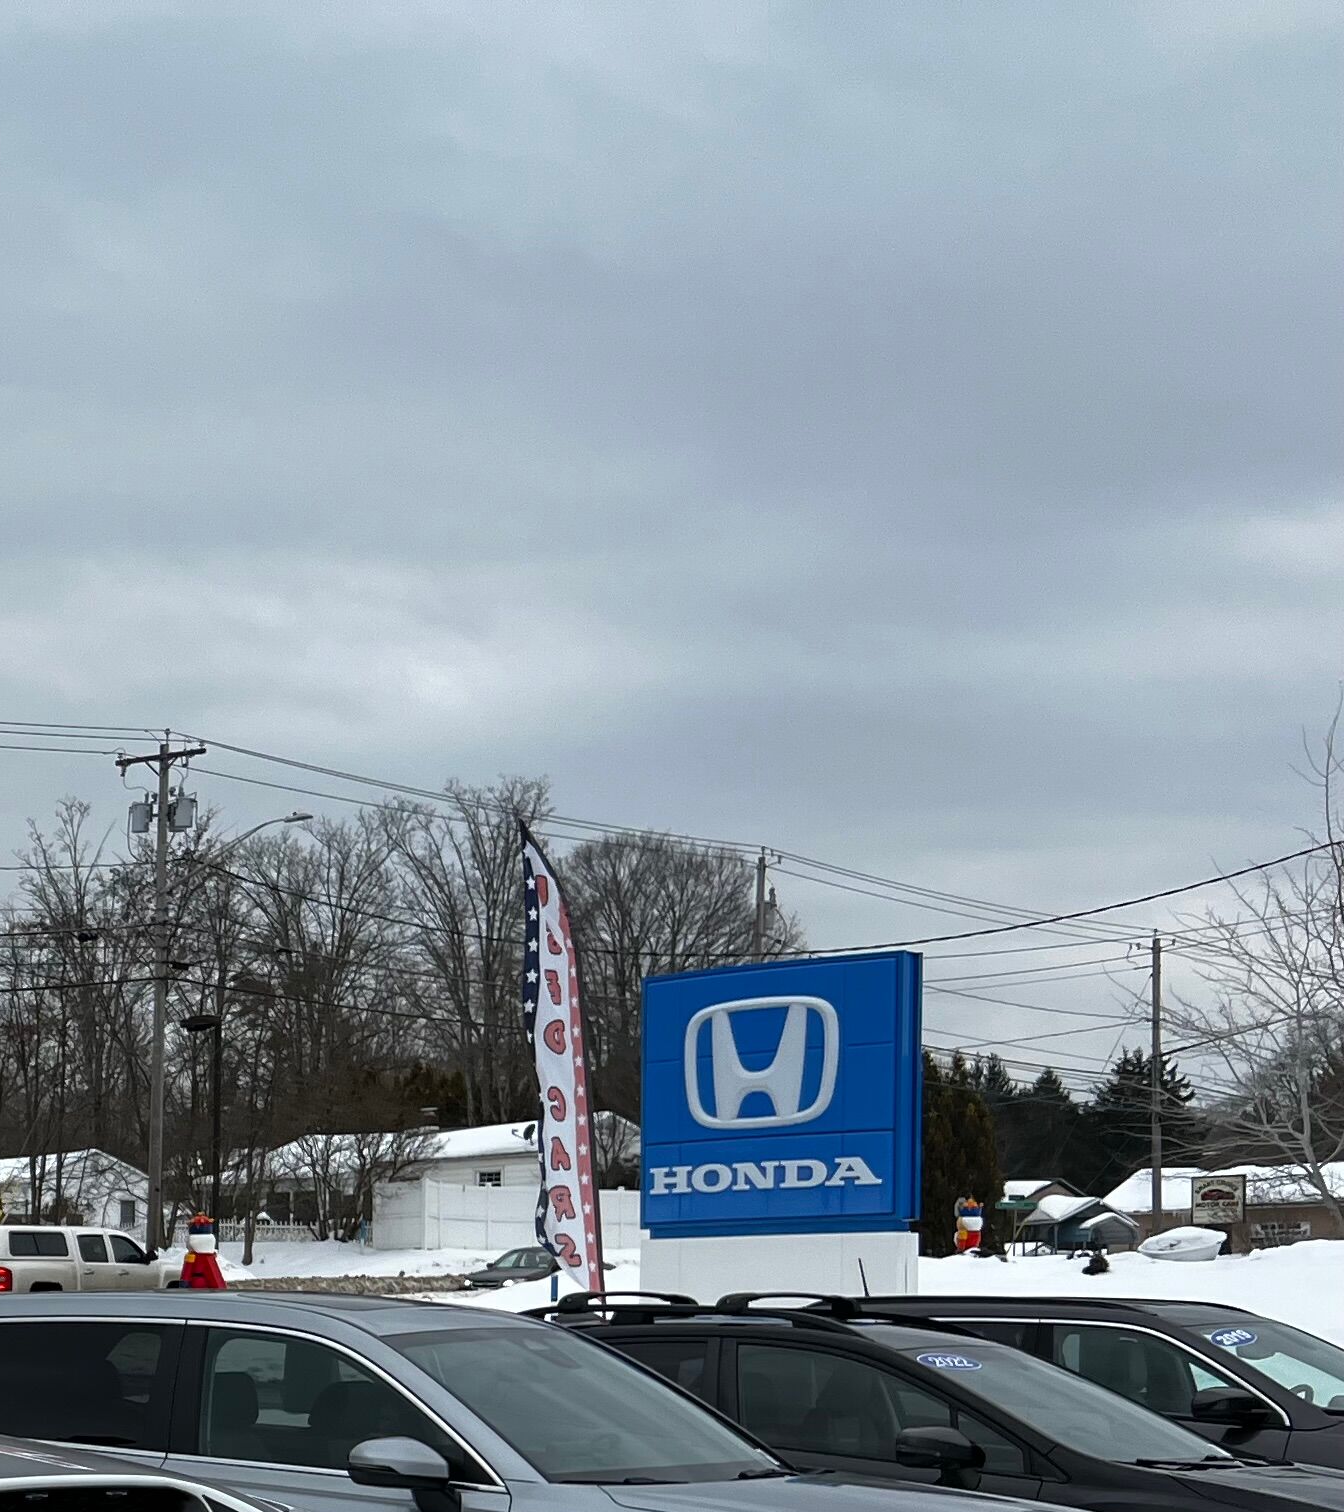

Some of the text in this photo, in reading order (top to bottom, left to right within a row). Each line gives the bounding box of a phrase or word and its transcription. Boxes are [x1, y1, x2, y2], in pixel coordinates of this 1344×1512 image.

[649, 1156, 883, 1195] HONDA
[1215, 1329, 1252, 1345] 2019
[927, 1356, 974, 1367] 2022
